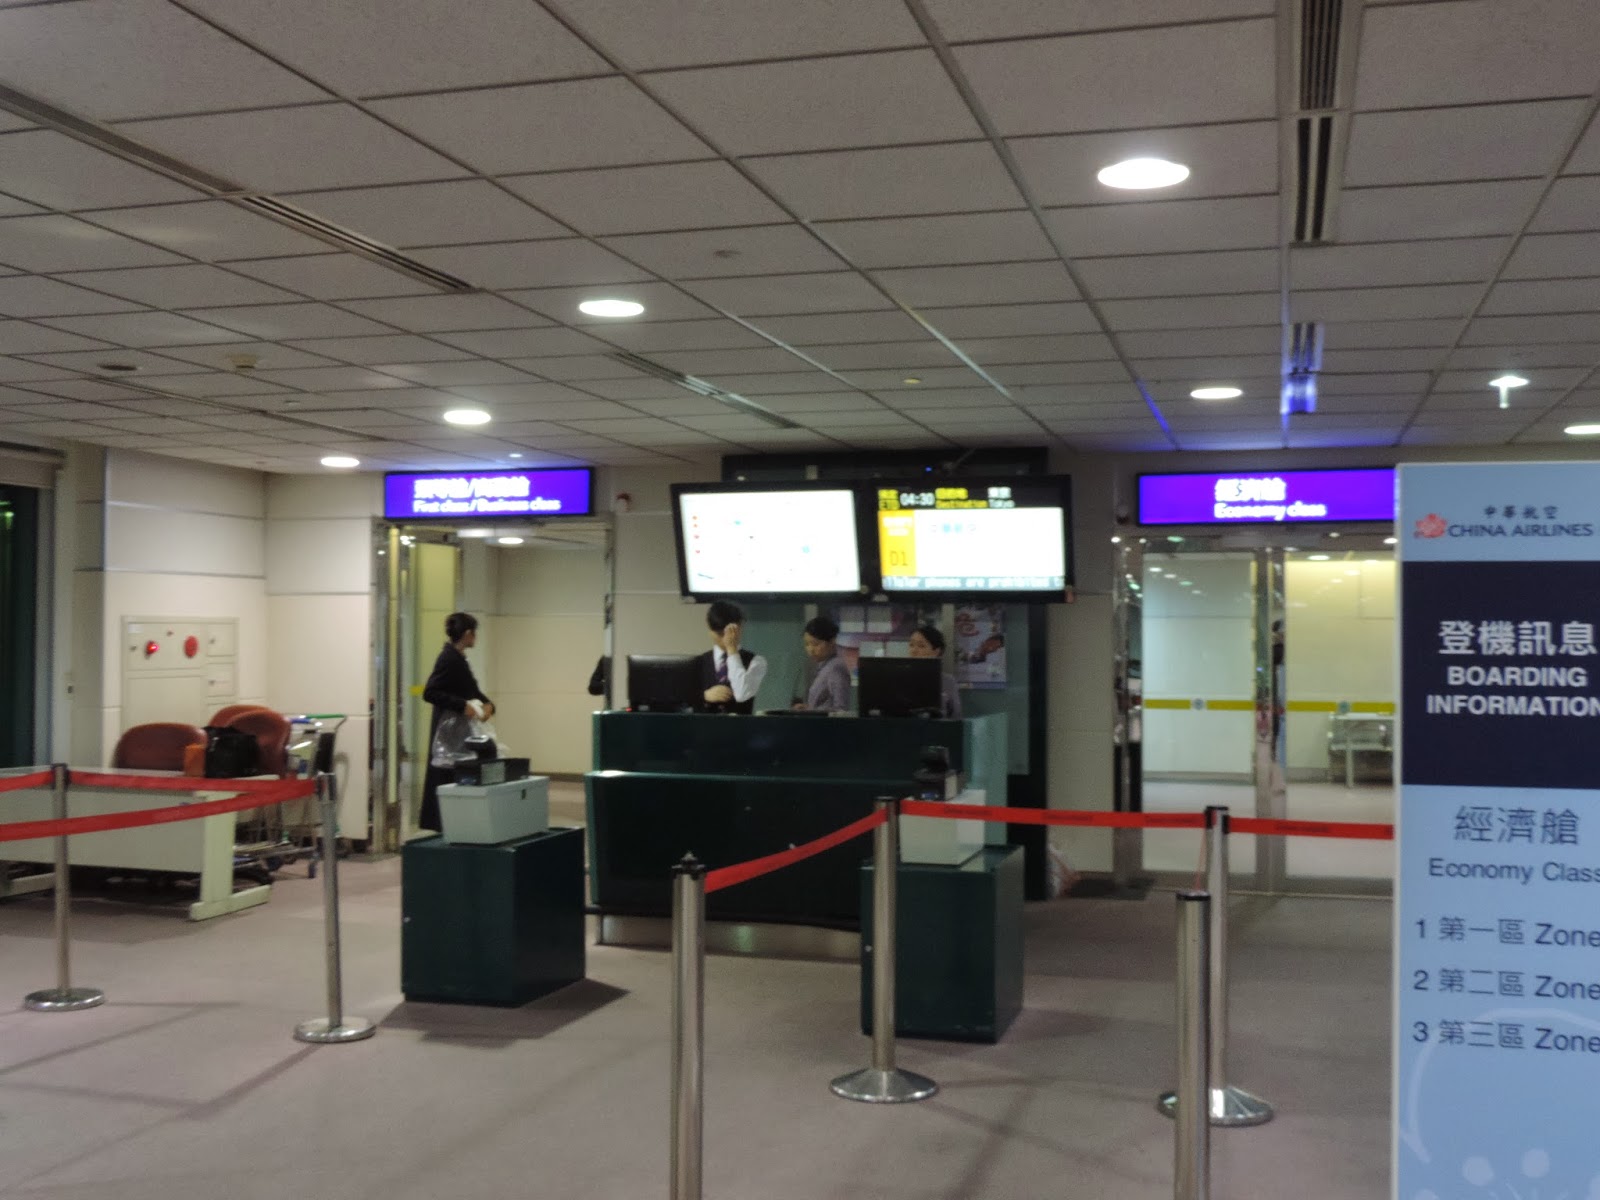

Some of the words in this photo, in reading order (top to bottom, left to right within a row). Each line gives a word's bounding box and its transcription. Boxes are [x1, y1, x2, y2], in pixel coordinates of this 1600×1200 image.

[1448, 523, 1504, 538] CHINA
[1513, 523, 1594, 537] AIRLINES
[1438, 620, 1598, 656] 登機訊息
[1447, 666, 1589, 687] BOARDING
[1454, 805, 1580, 845] 經濟艙
[1428, 857, 1533, 885] Economy
[1542, 861, 1600, 883] Class
[1416, 918, 1426, 939] 1
[1438, 916, 1525, 944] 第一區
[1534, 923, 1600, 948] Zone
[1413, 970, 1429, 991] 2
[1438, 968, 1525, 997] 第二區
[1534, 975, 1600, 1000] Zone
[1413, 1021, 1429, 1042] 3
[1438, 1018, 1525, 1049] 第三區
[1534, 1027, 1600, 1053] Zone
